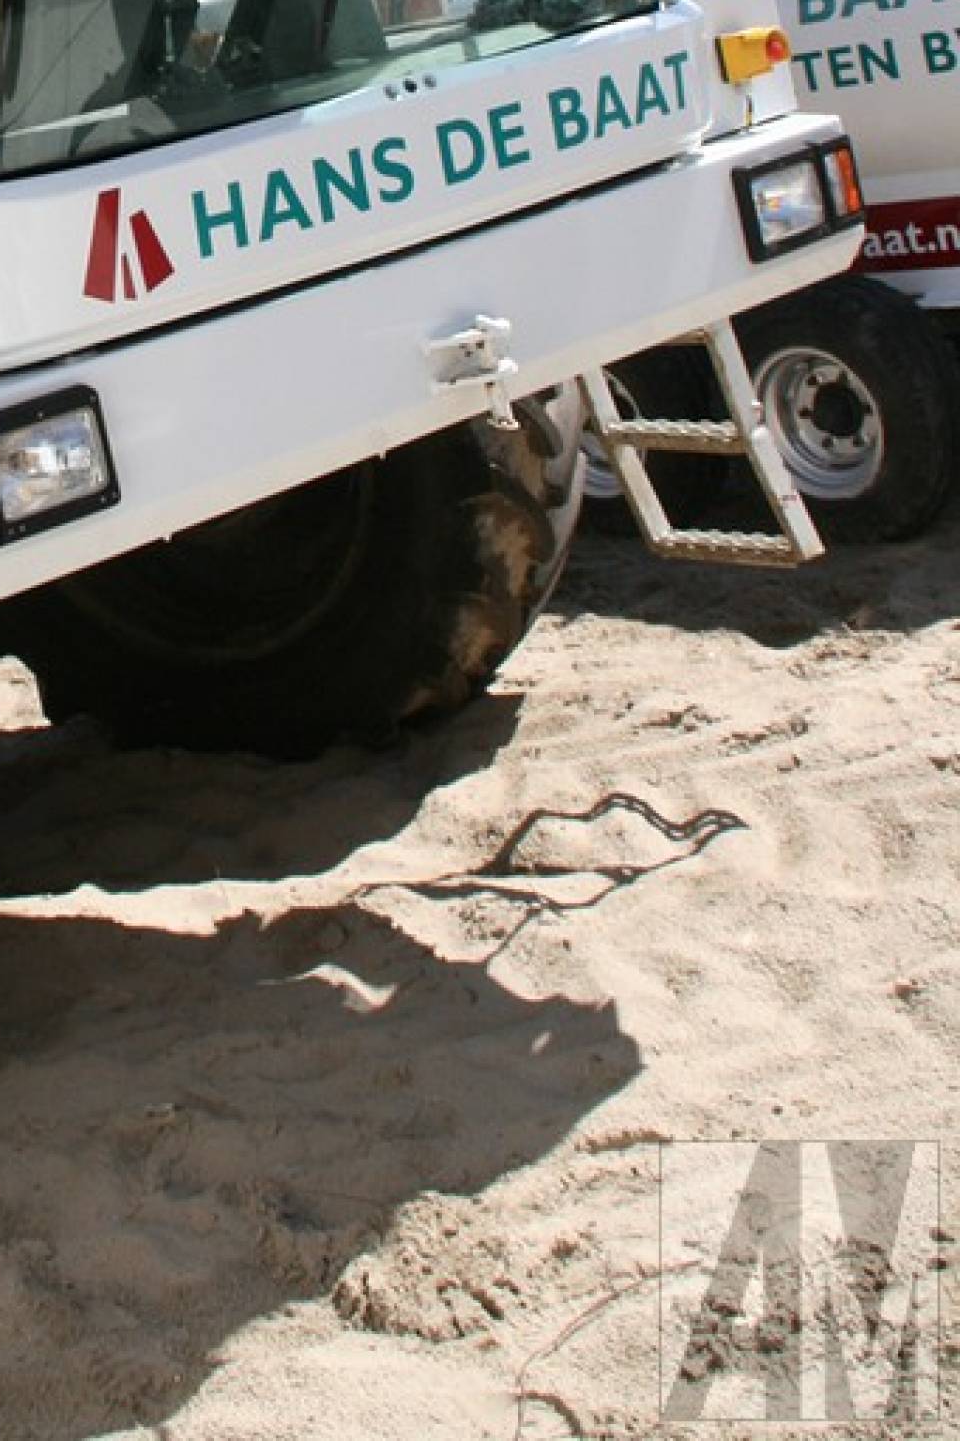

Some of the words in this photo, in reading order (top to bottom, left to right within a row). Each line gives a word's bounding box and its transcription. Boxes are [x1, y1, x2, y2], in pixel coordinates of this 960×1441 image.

[190, 136, 416, 258] HANS
[435, 101, 531, 187] DE
[547, 51, 689, 150] BAAT
